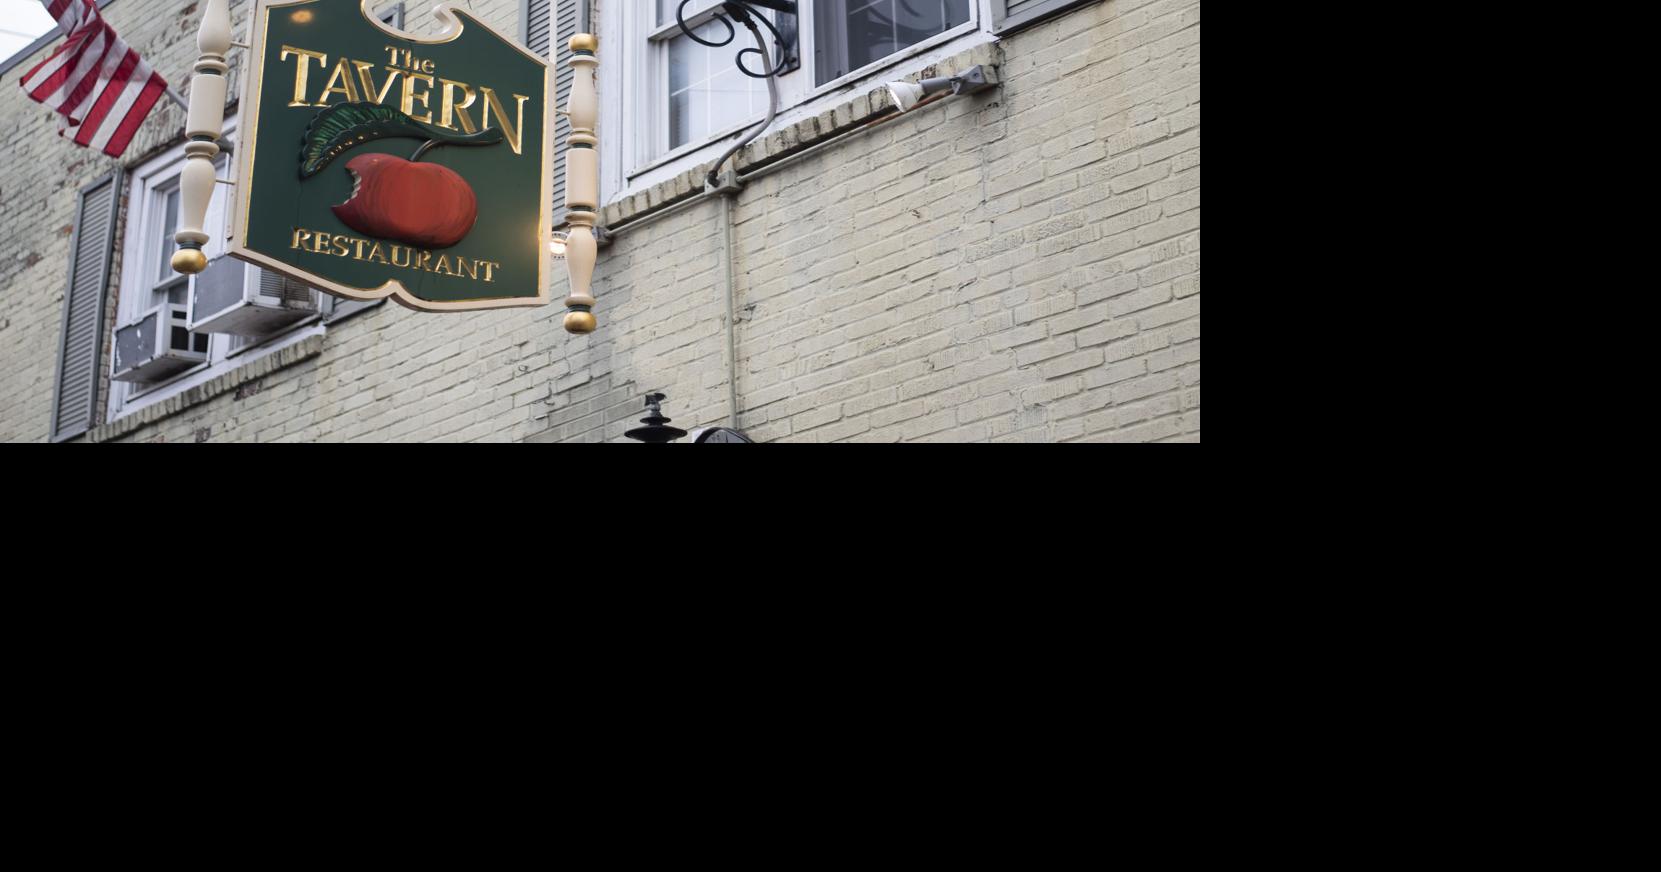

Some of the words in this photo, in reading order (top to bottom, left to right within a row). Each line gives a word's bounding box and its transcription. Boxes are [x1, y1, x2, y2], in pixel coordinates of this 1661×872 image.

[385, 46, 435, 74] The
[280, 45, 529, 155] TAVERN
[290, 227, 499, 282] RESTAURANT
